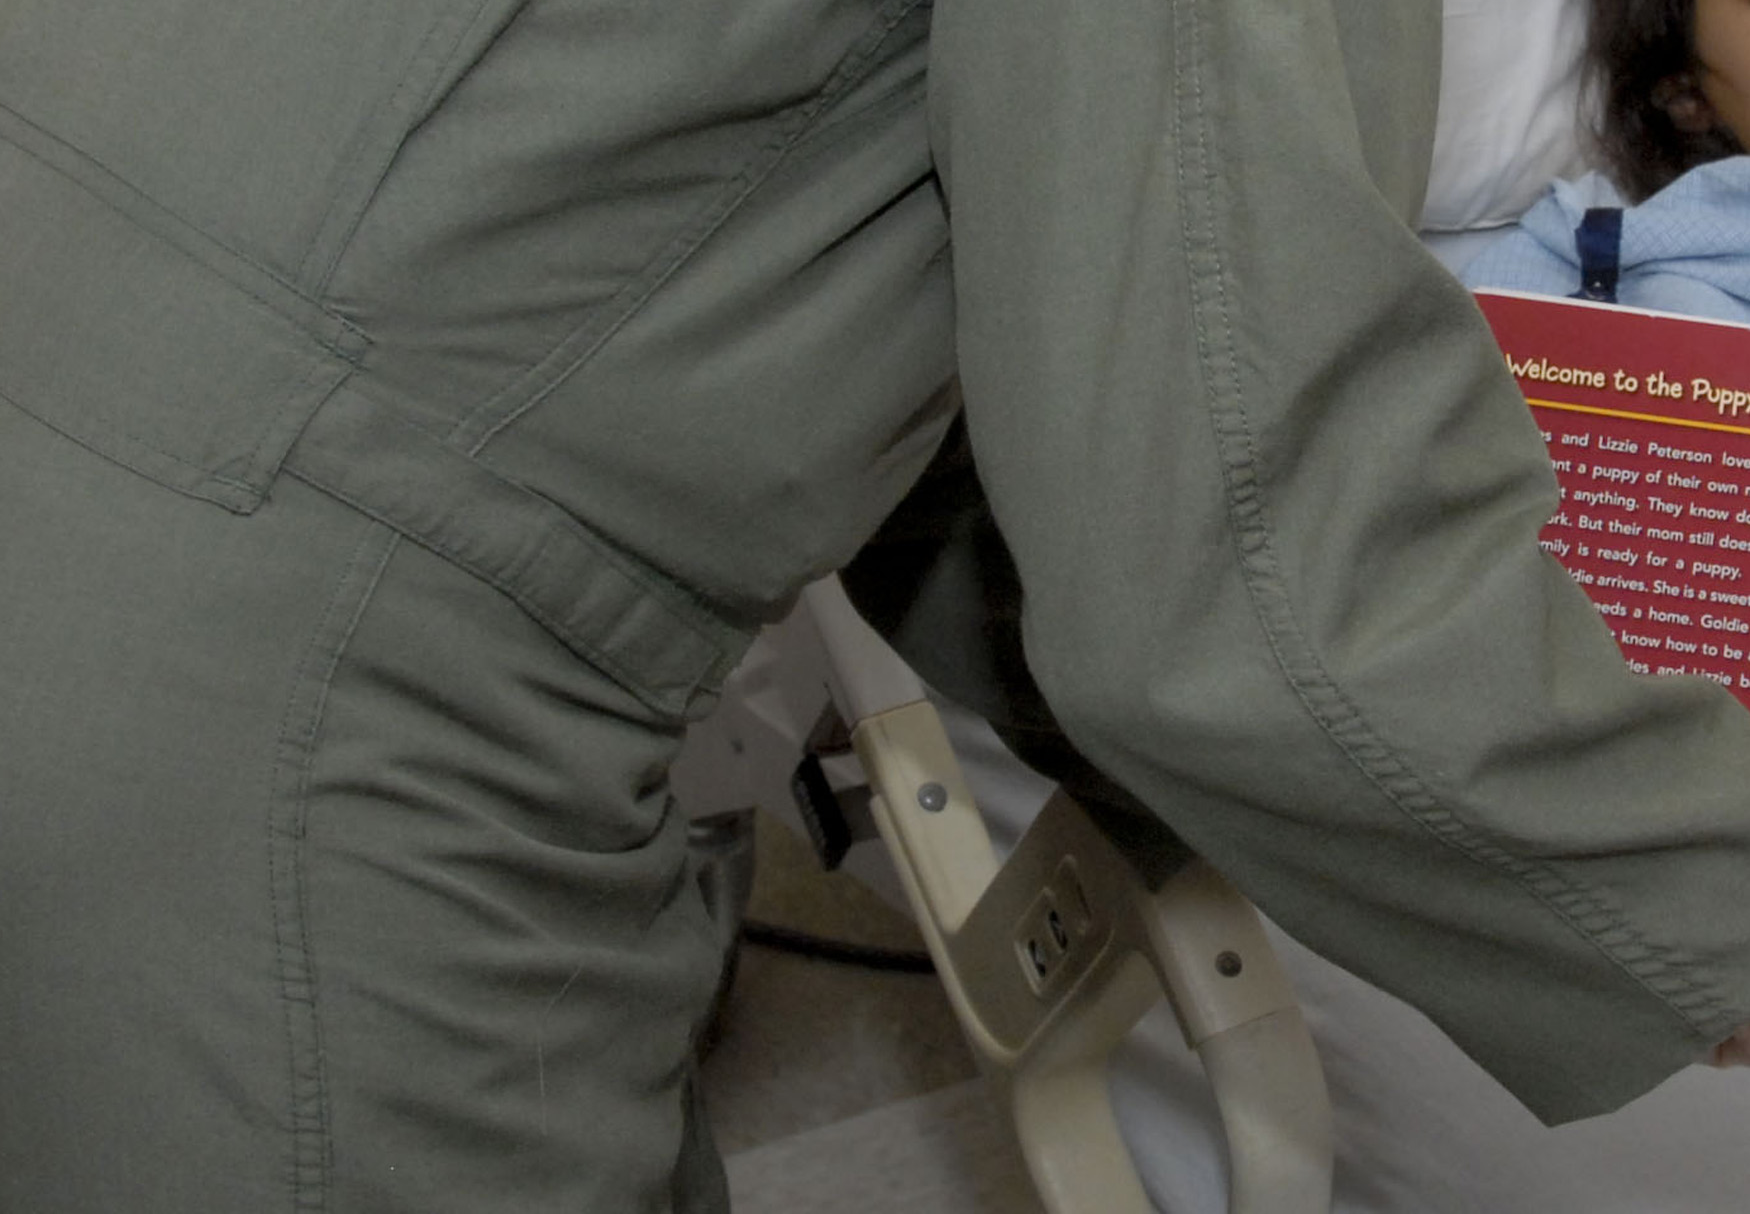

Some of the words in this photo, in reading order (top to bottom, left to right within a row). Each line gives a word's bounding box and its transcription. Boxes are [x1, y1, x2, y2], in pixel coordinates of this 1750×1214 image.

[1505, 353, 1606, 388] Welcome
[1613, 369, 1638, 392] to
[1646, 371, 1683, 399] the
[1562, 433, 1590, 447] and
[1599, 436, 1639, 453] Lizzie
[1648, 442, 1713, 464] Peterson
[1578, 464, 1587, 474] a
[1592, 466, 1640, 485] puppy
[1646, 470, 1663, 484] of
[1667, 473, 1701, 489] their
[1707, 482, 1739, 494] own
[1574, 491, 1640, 511] anything.
[1648, 497, 1683, 518] They
[1690, 502, 1730, 521] know
[1579, 515, 1603, 531] But
[1609, 519, 1643, 536] their
[1647, 528, 1683, 542] mom
[1689, 532, 1714, 546] still
[1578, 542, 1589, 557] is
[1597, 549, 1639, 567] ready
[1647, 551, 1668, 567] for
[1676, 559, 1685, 570] a
[1692, 562, 1742, 581] puppy.
[1597, 575, 1649, 593] arrives.
[1653, 580, 1681, 597] She
[1683, 585, 1695, 599] is
[1698, 590, 1708, 601] a
[1633, 608, 1643, 619] a
[1649, 606, 1694, 626] home.
[1701, 614, 1750, 634] Goldie
[1622, 630, 1662, 648] know
[1666, 636, 1698, 654] how
[1702, 644, 1719, 657] to
[1723, 644, 1743, 660] be
